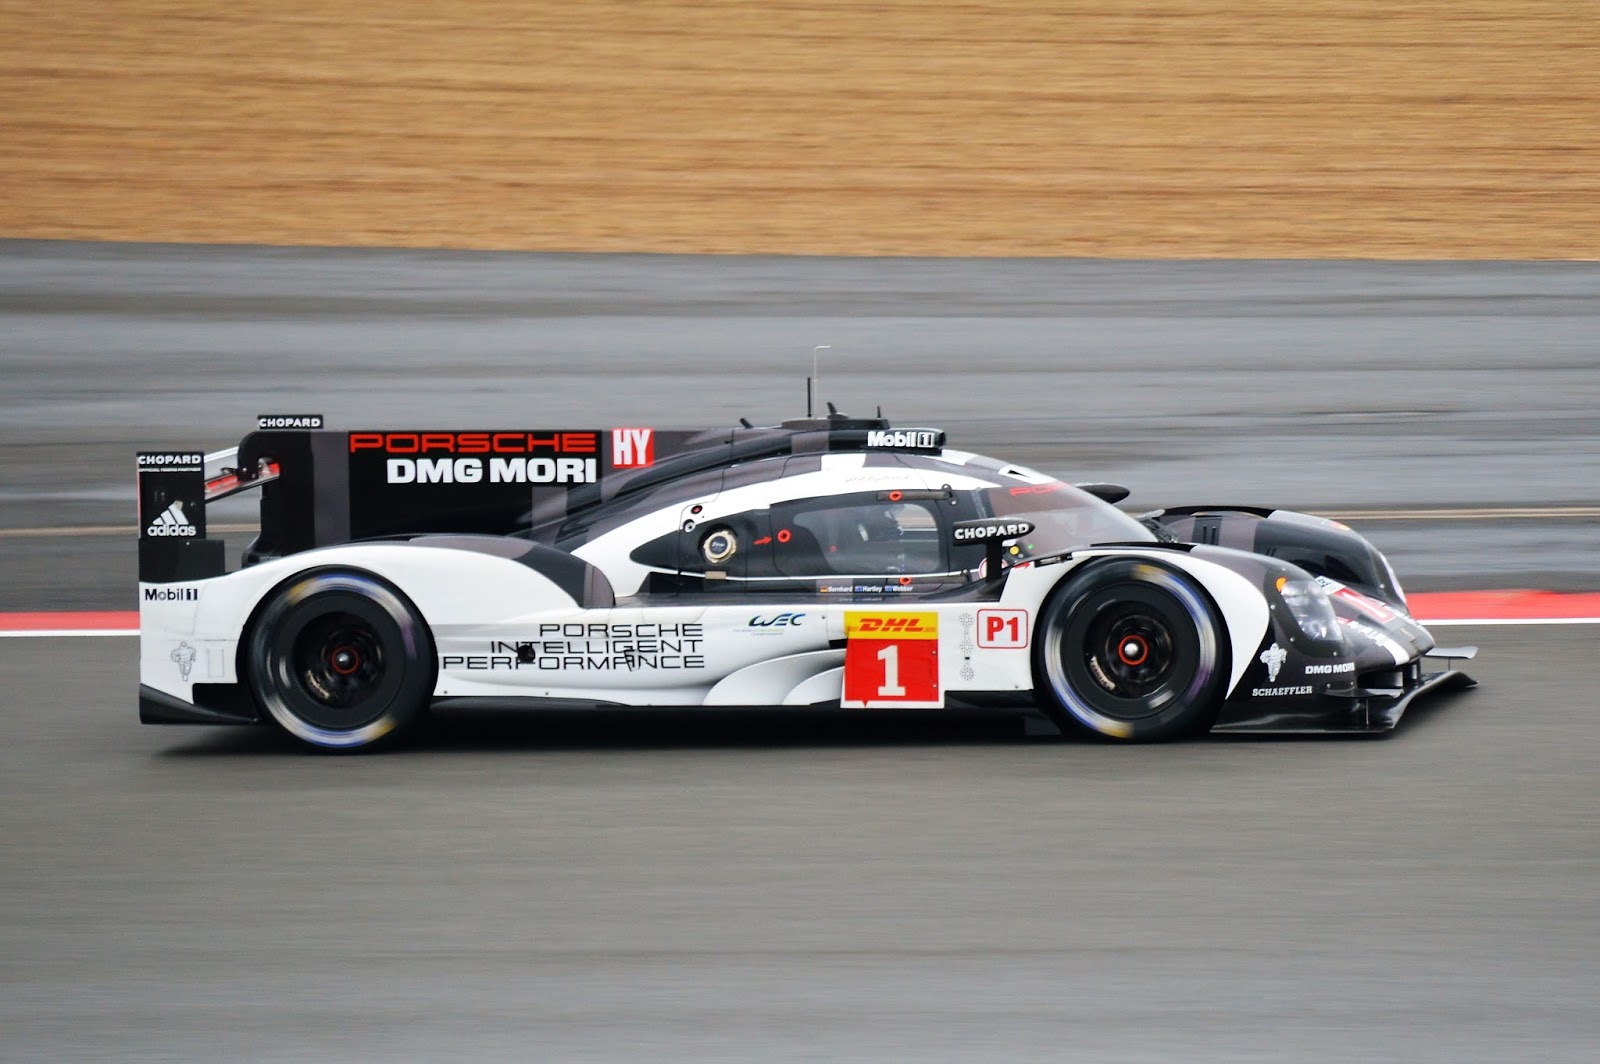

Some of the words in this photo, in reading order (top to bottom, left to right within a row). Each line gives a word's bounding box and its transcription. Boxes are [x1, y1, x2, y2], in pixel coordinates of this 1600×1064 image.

[259, 417, 321, 428] CHOPARD
[350, 433, 596, 453] PORSCHE
[868, 431, 917, 447] Mobil
[613, 429, 650, 465] HY
[138, 455, 202, 465] CHOPARD
[387, 458, 483, 484] DMG
[489, 458, 597, 484] MORI
[147, 524, 196, 537] adidas
[954, 523, 1030, 540] CHOPARD
[144, 588, 184, 601] Mobil
[748, 613, 806, 626] WEC
[858, 618, 924, 632] DHL
[539, 623, 703, 638] PORSCHE
[986, 616, 1019, 642] P1
[490, 639, 703, 654] INTELLIGENT
[876, 644, 906, 696] 1
[1305, 665, 1332, 674] DMG
[1252, 686, 1313, 697] SCHAEFFLER
